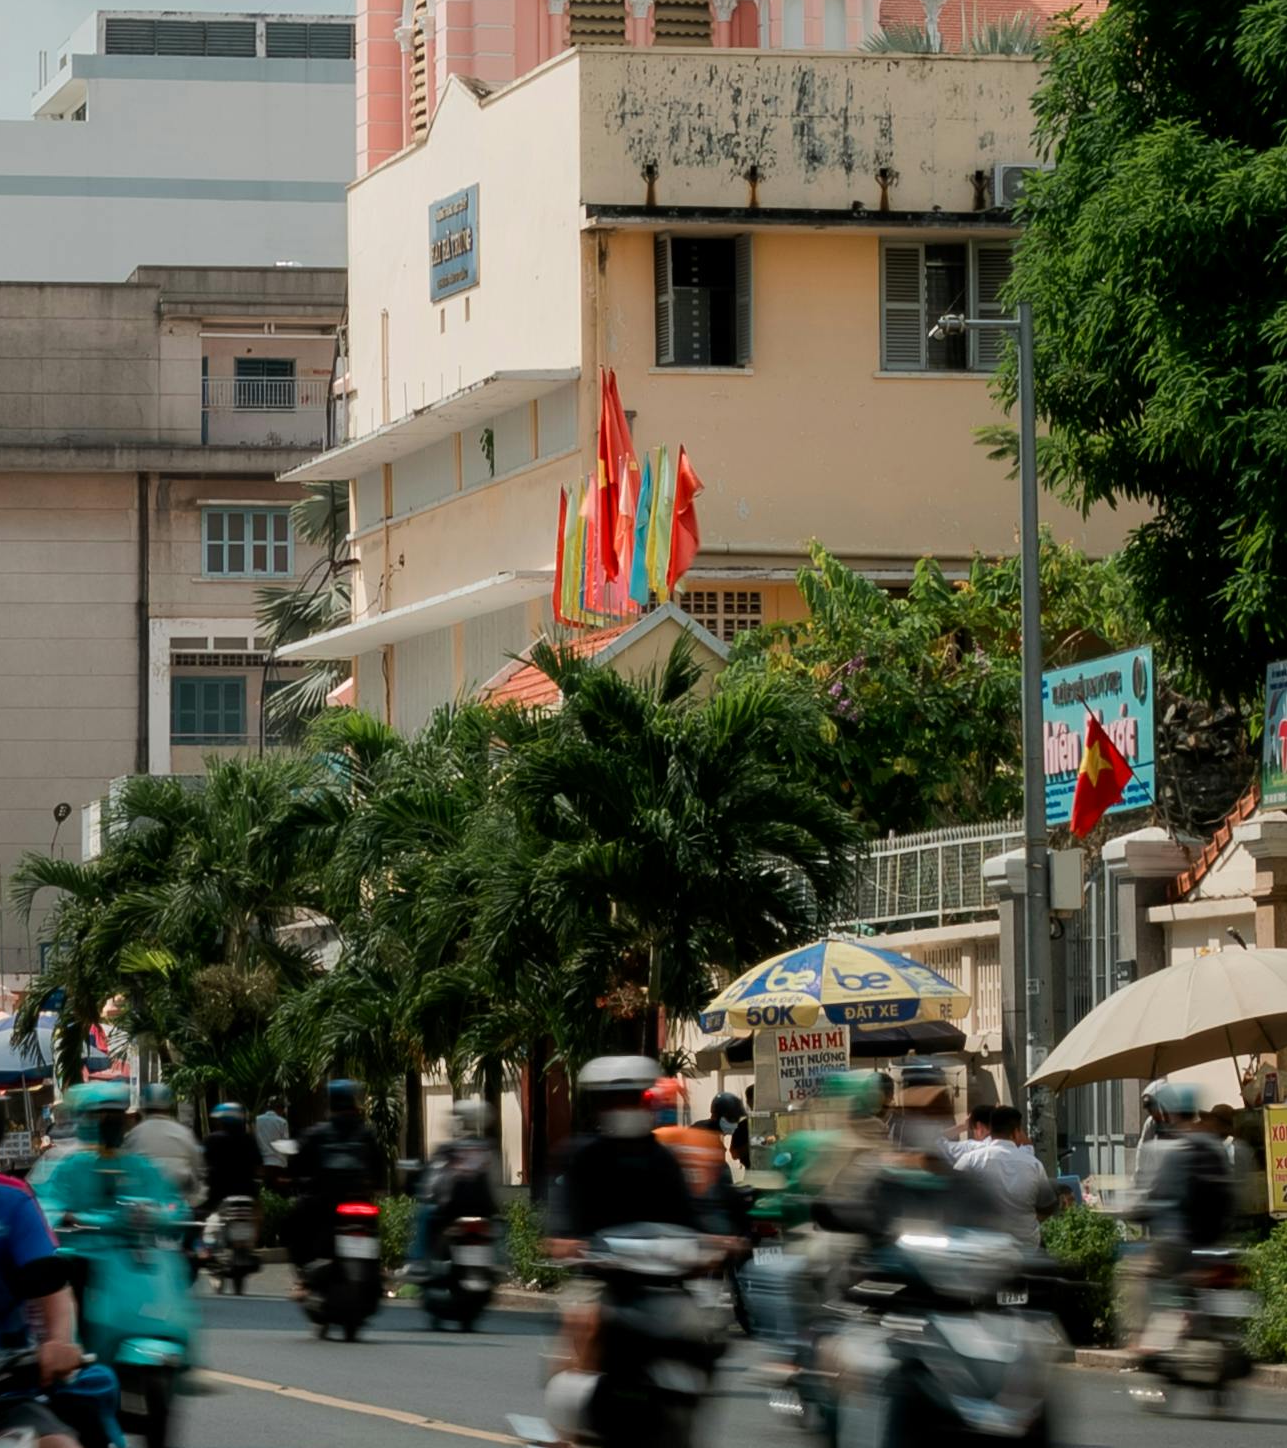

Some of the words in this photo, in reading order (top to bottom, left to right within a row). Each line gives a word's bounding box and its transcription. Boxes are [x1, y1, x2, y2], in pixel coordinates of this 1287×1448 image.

[766, 964, 816, 991] be
[831, 966, 892, 991] be
[746, 1005, 797, 1026] 50K
[879, 1004, 899, 1017] XE
[778, 1030, 822, 1052] BÁNH
[780, 1056, 805, 1068] THỊT
[780, 1067, 805, 1079] NEM
